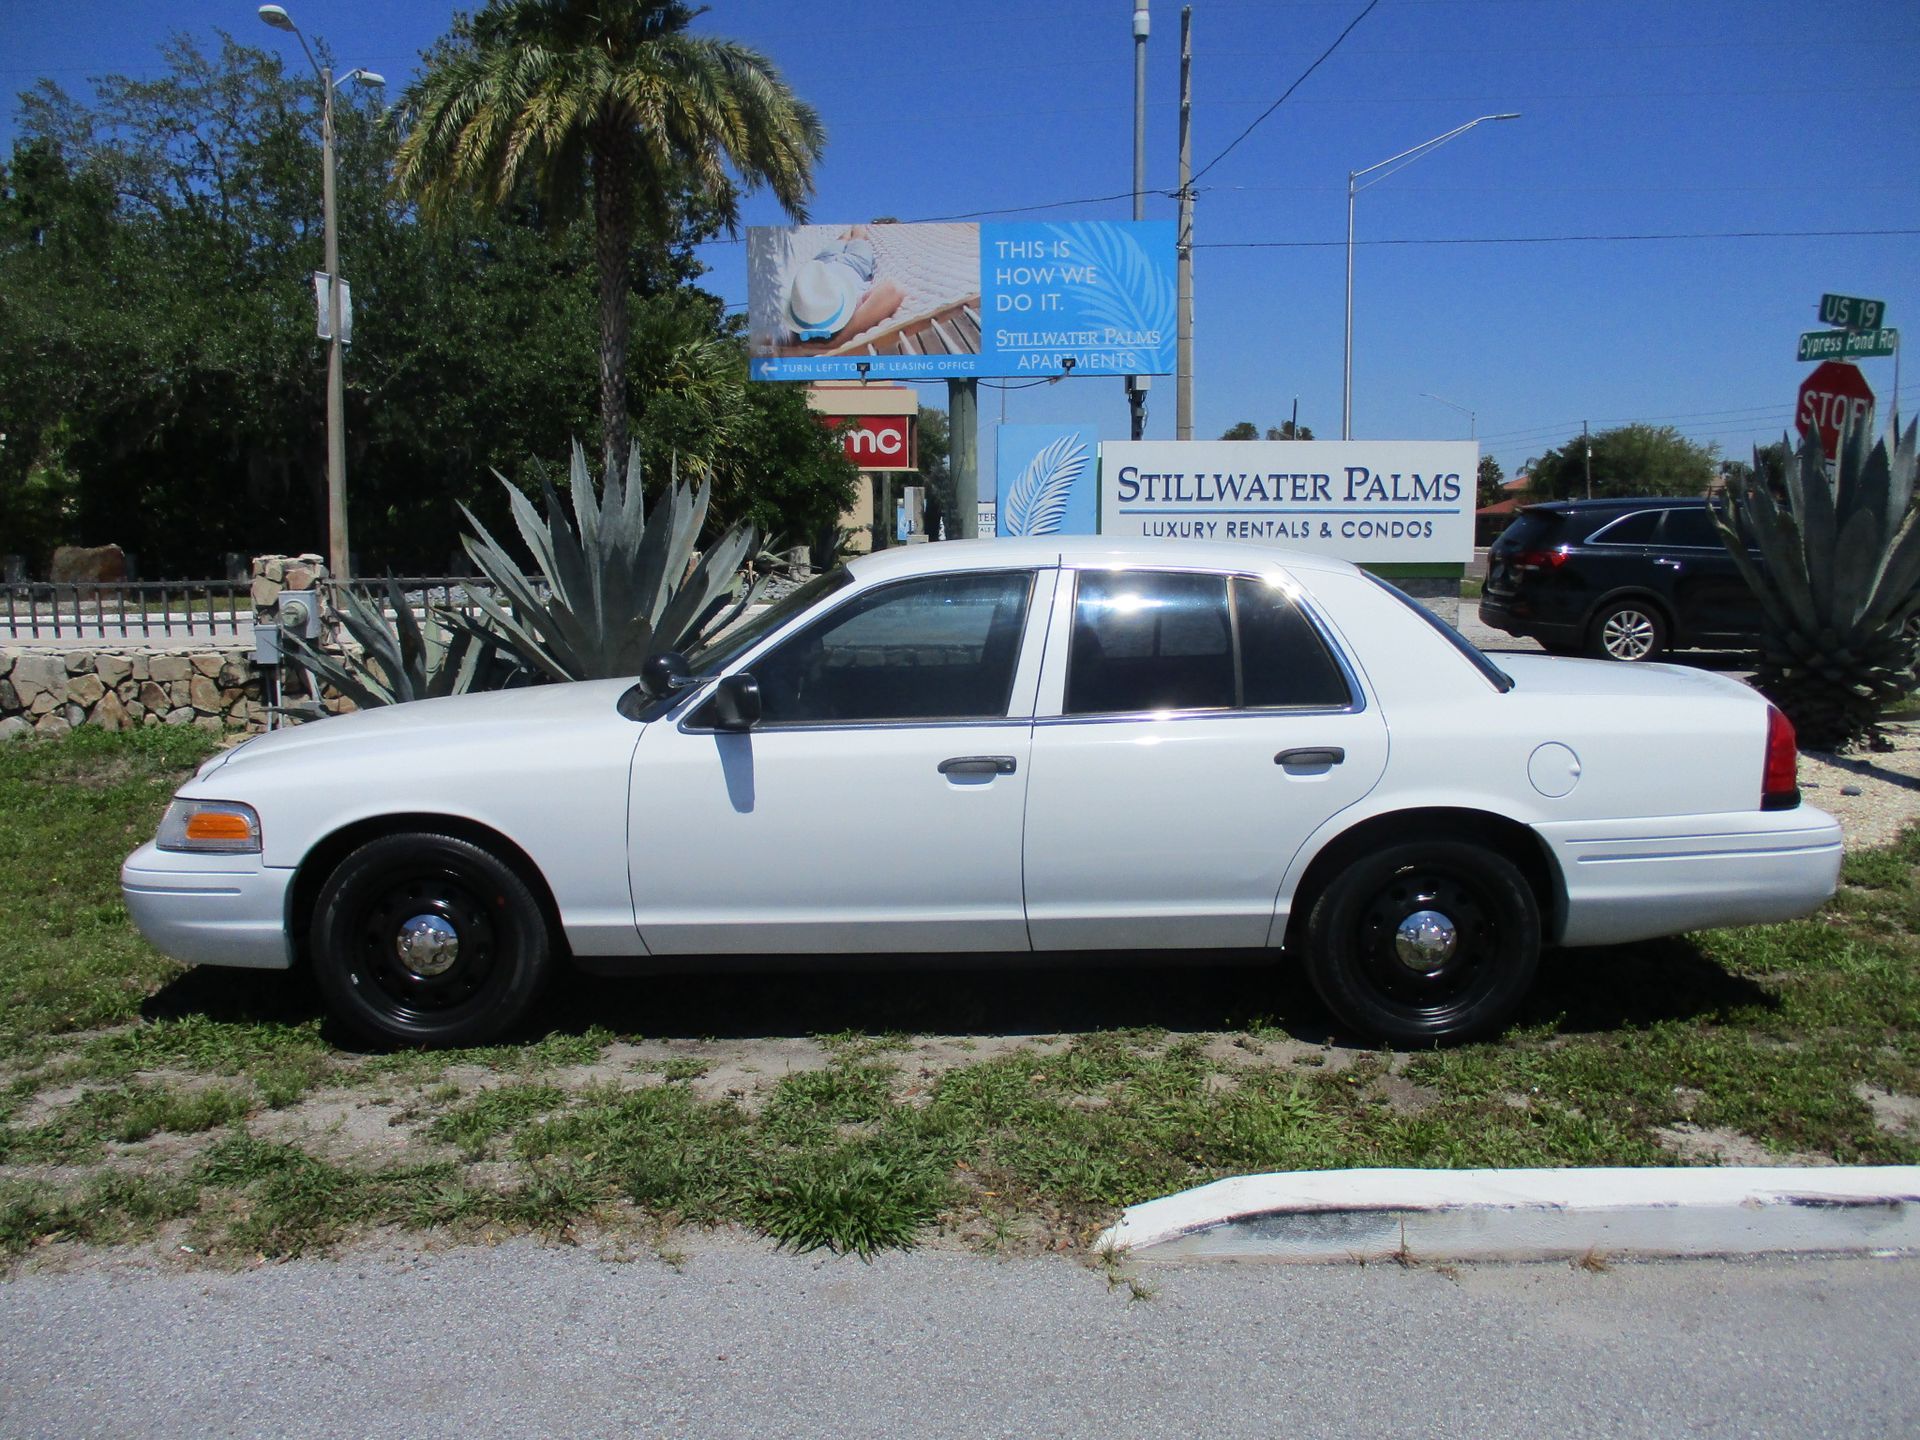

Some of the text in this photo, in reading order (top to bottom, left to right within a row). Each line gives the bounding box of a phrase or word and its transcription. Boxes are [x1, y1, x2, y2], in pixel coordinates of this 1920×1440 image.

[995, 240, 1070, 258] THIS IS
[996, 267, 1097, 285] HOW WE
[997, 293, 1064, 311] DO IT.
[1826, 296, 1877, 328] US 19
[996, 328, 1160, 347] STILLWATER PALMS
[1799, 329, 1897, 359] Cypress Pond Rd
[782, 363, 812, 373] TURN
[816, 363, 839, 372] LEFT
[843, 362, 858, 371] TO
[889, 361, 934, 371] LEASING
[938, 360, 975, 370] OFFICE
[1117, 466, 1461, 502] STILLWATER PALMS
[1142, 521, 1433, 538] LUXURY RENTALS & CONDOS
